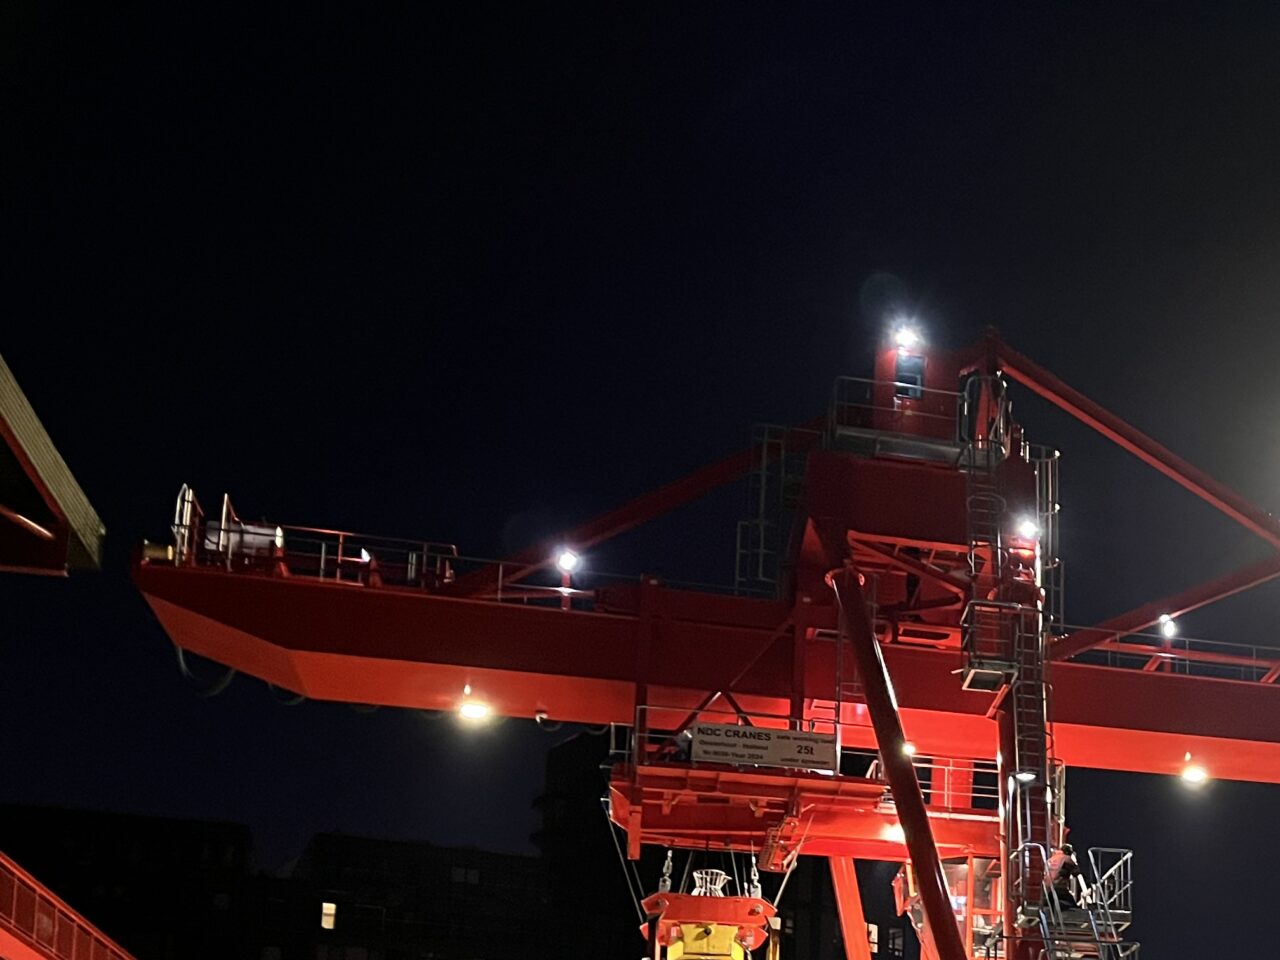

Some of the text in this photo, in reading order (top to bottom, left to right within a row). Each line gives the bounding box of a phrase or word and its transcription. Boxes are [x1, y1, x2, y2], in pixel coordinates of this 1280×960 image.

[697, 727, 771, 741] NDC CRANES
[796, 744, 814, 755] 25t
